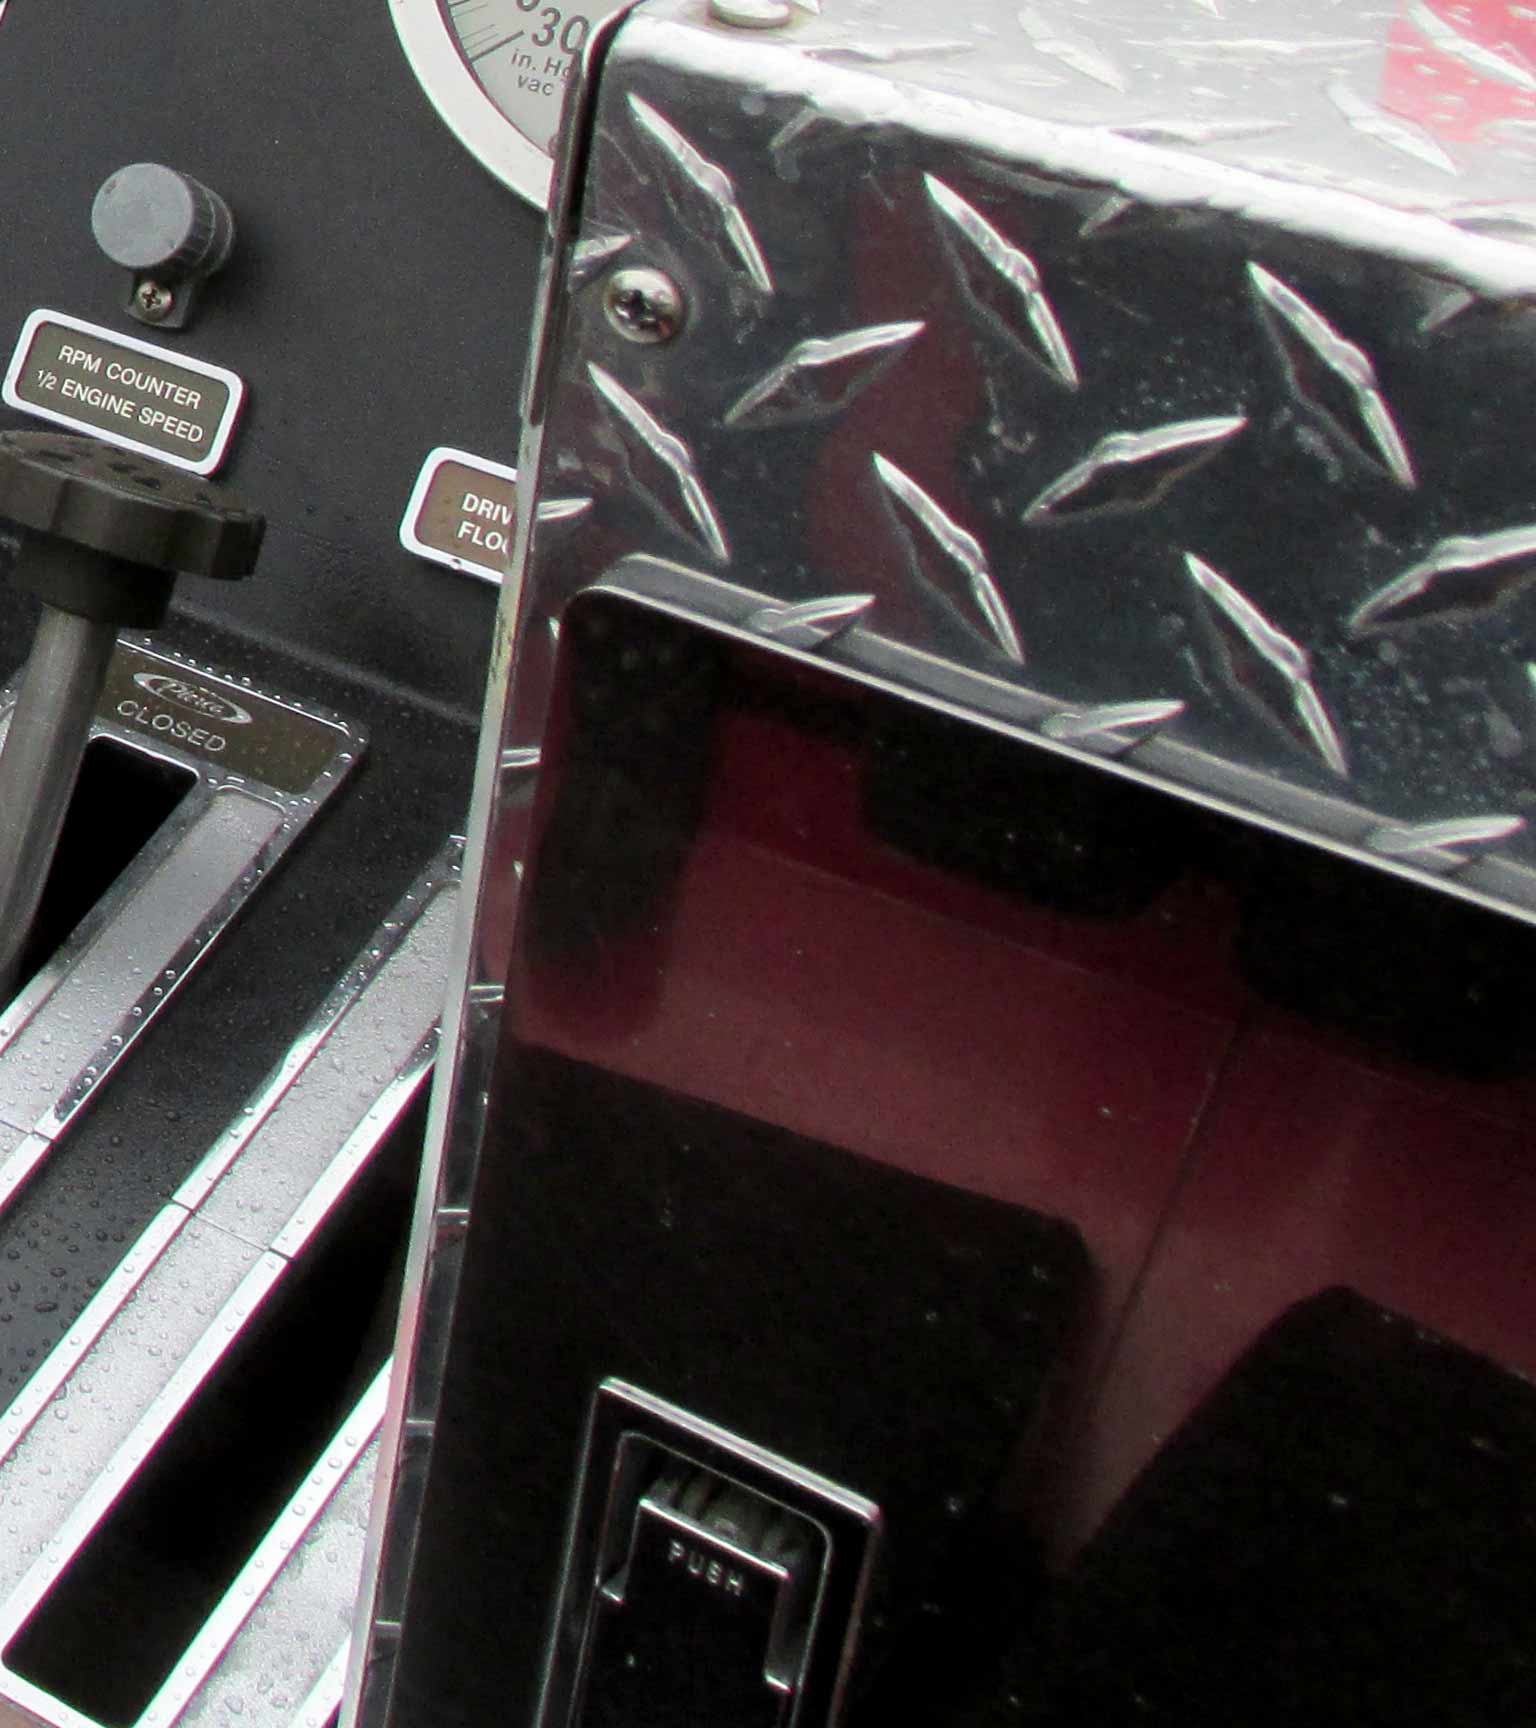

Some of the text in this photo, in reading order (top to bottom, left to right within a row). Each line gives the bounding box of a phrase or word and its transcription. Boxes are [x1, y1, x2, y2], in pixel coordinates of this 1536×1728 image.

[511, 48, 536, 70] in.
[531, 7, 590, 54] 30
[517, 75, 554, 96] vac
[57, 344, 203, 411] RPM COUNTER
[60, 378, 135, 419] ENGINE
[137, 406, 205, 445] SPEED
[115, 698, 227, 755] CLOSED
[667, 1538, 747, 1597] PUSH
